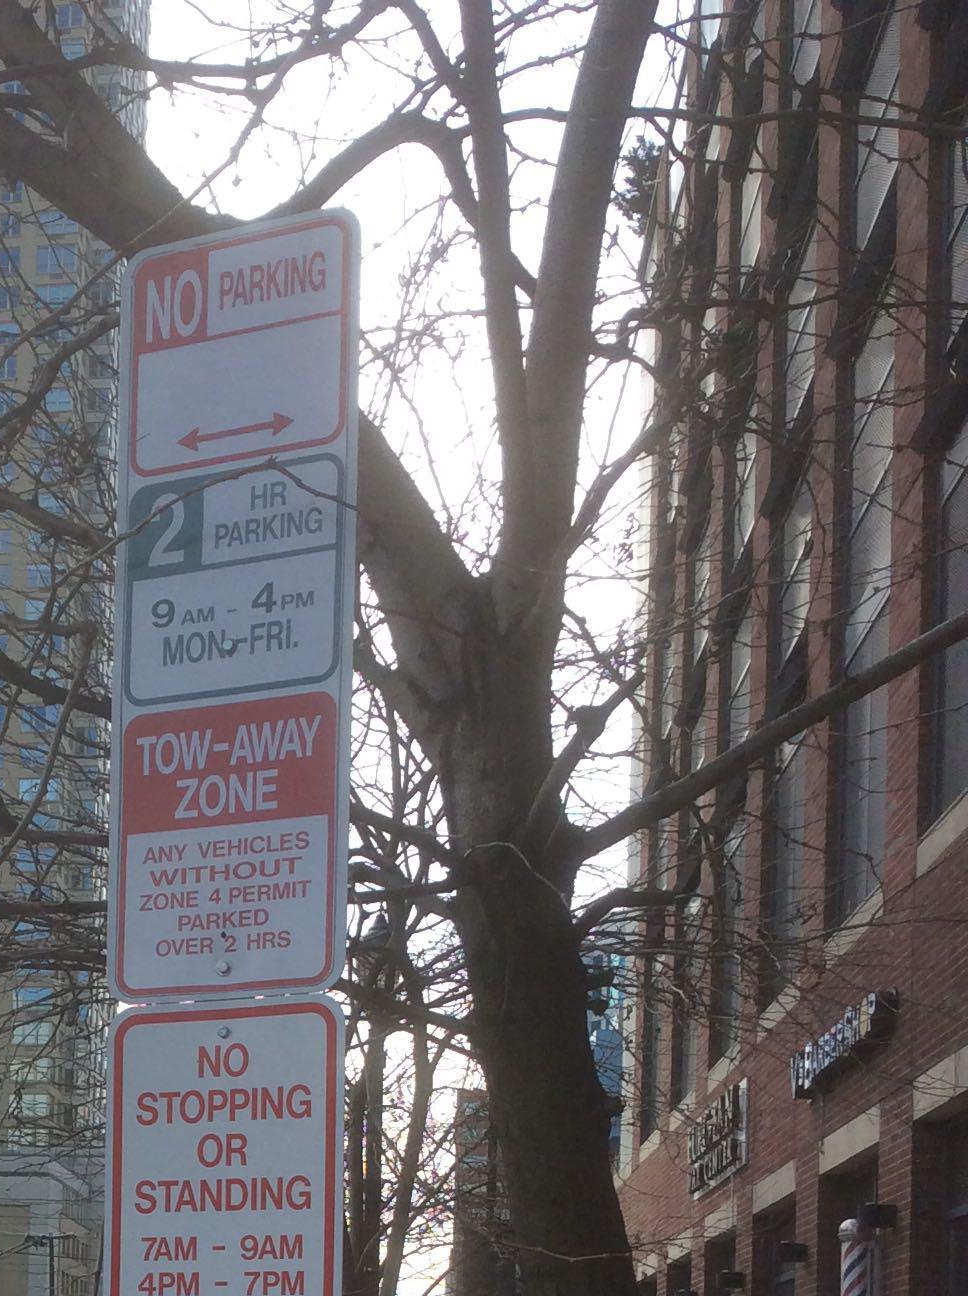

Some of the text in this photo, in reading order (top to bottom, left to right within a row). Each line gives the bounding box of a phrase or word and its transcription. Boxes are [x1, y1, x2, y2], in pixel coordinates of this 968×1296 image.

[146, 250, 326, 343] NO PARKING
[148, 480, 287, 567] 2 HR
[214, 506, 323, 550] PARKING
[181, 607, 215, 625] AM
[281, 590, 315, 610] PM
[136, 715, 321, 776] TOW-AWAY
[174, 769, 278, 820] ZONE
[142, 831, 310, 865] ANY VEHICLES
[149, 856, 302, 888] WITHOUT
[139, 879, 312, 912] ZONE 4 PERMIT
[177, 908, 270, 932] PARKED
[155, 930, 292, 957] OVER 2 HRS
[197, 1042, 249, 1078] NO
[136, 1083, 312, 1127] STOPPING
[197, 1133, 248, 1168] OR
[134, 1175, 312, 1215] STANDING
[140, 1236, 198, 1262] 7AM
[240, 1234, 304, 1261] 9AM
[138, 1271, 200, 1296] 4PM
[243, 1271, 305, 1296] 7PM
